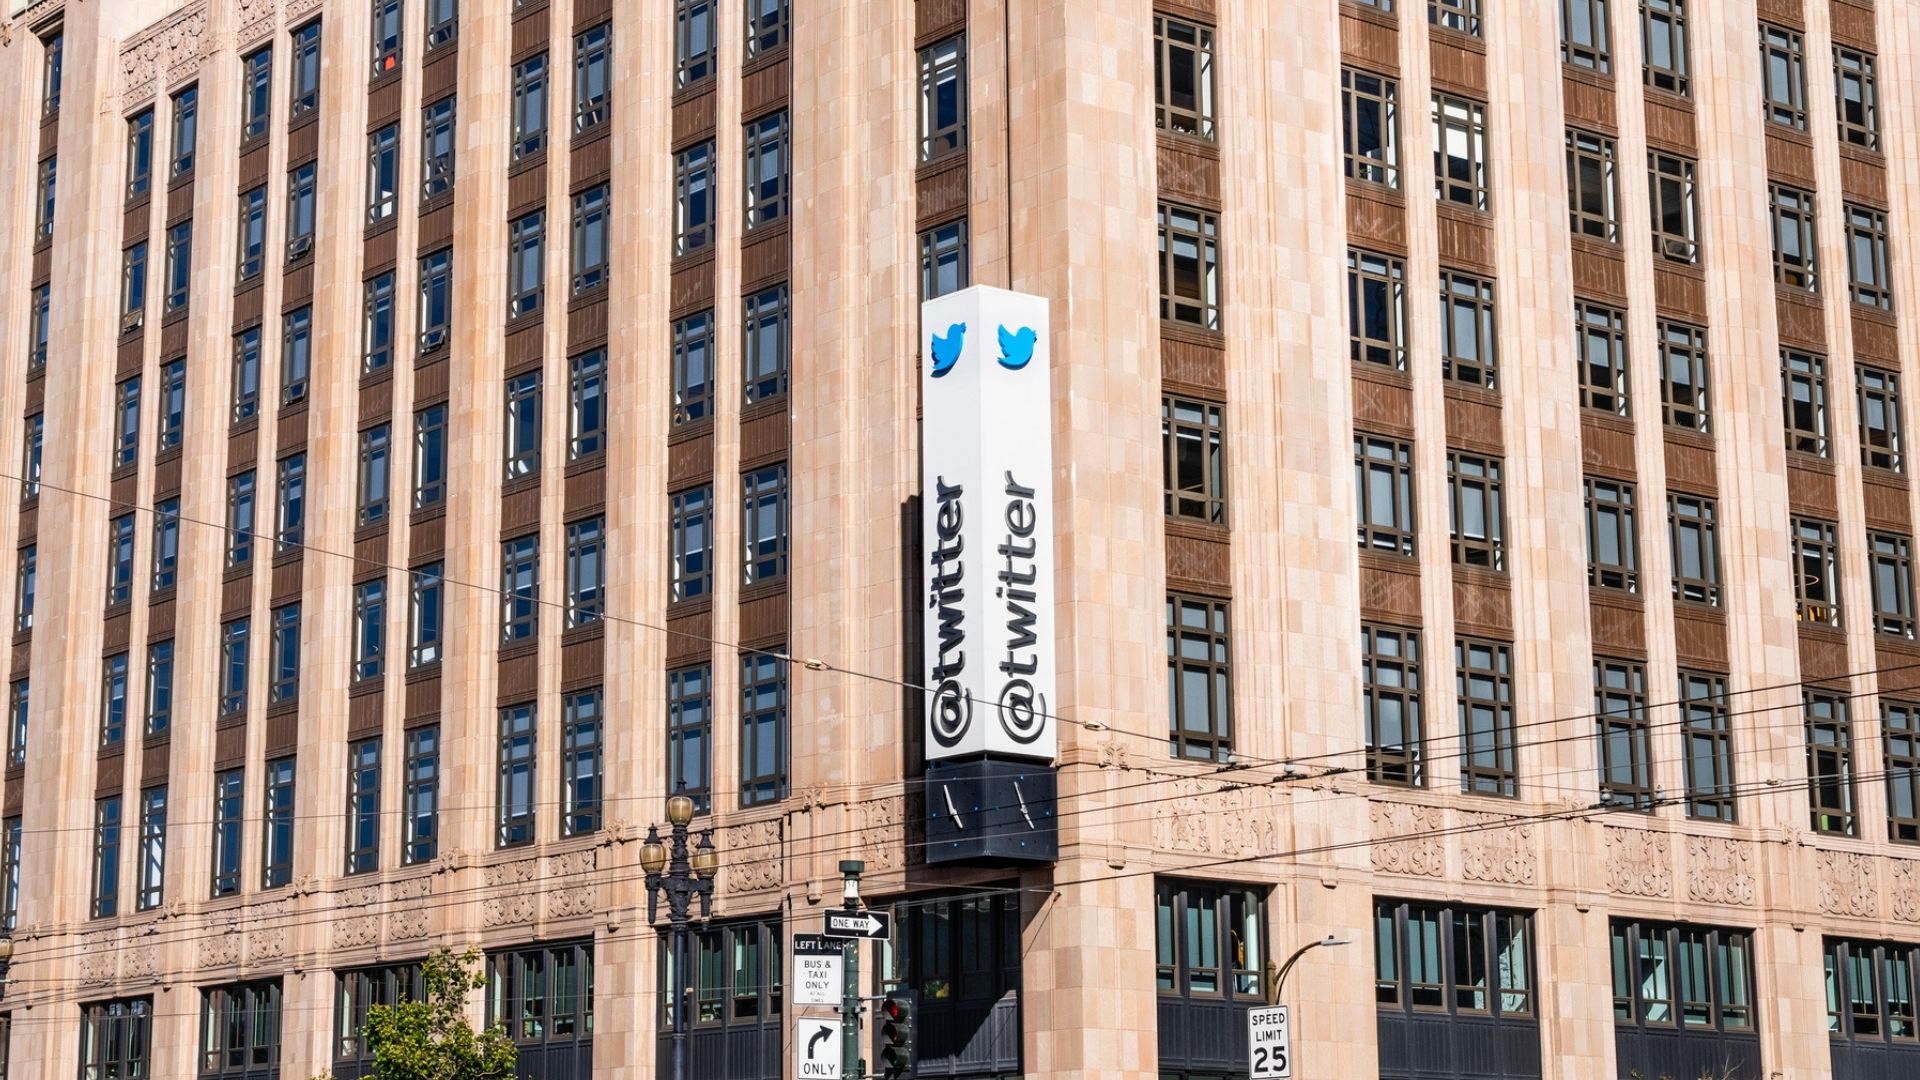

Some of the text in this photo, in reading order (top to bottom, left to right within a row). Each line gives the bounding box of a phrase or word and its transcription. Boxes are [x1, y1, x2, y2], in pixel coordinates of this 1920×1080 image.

[930, 475, 973, 748] @twitter
[998, 470, 1047, 744] @twitter
[832, 918, 870, 929] ONE WAY
[795, 940, 842, 950] LEFT LANE
[804, 960, 832, 969] BUS &
[808, 970, 827, 979] TAXI
[805, 981, 829, 989] ONLY
[1252, 1013, 1285, 1026] SPEED
[1255, 1029, 1282, 1042] LIMIT
[1253, 1046, 1287, 1073] 25
[803, 1062, 836, 1075] ONLY
